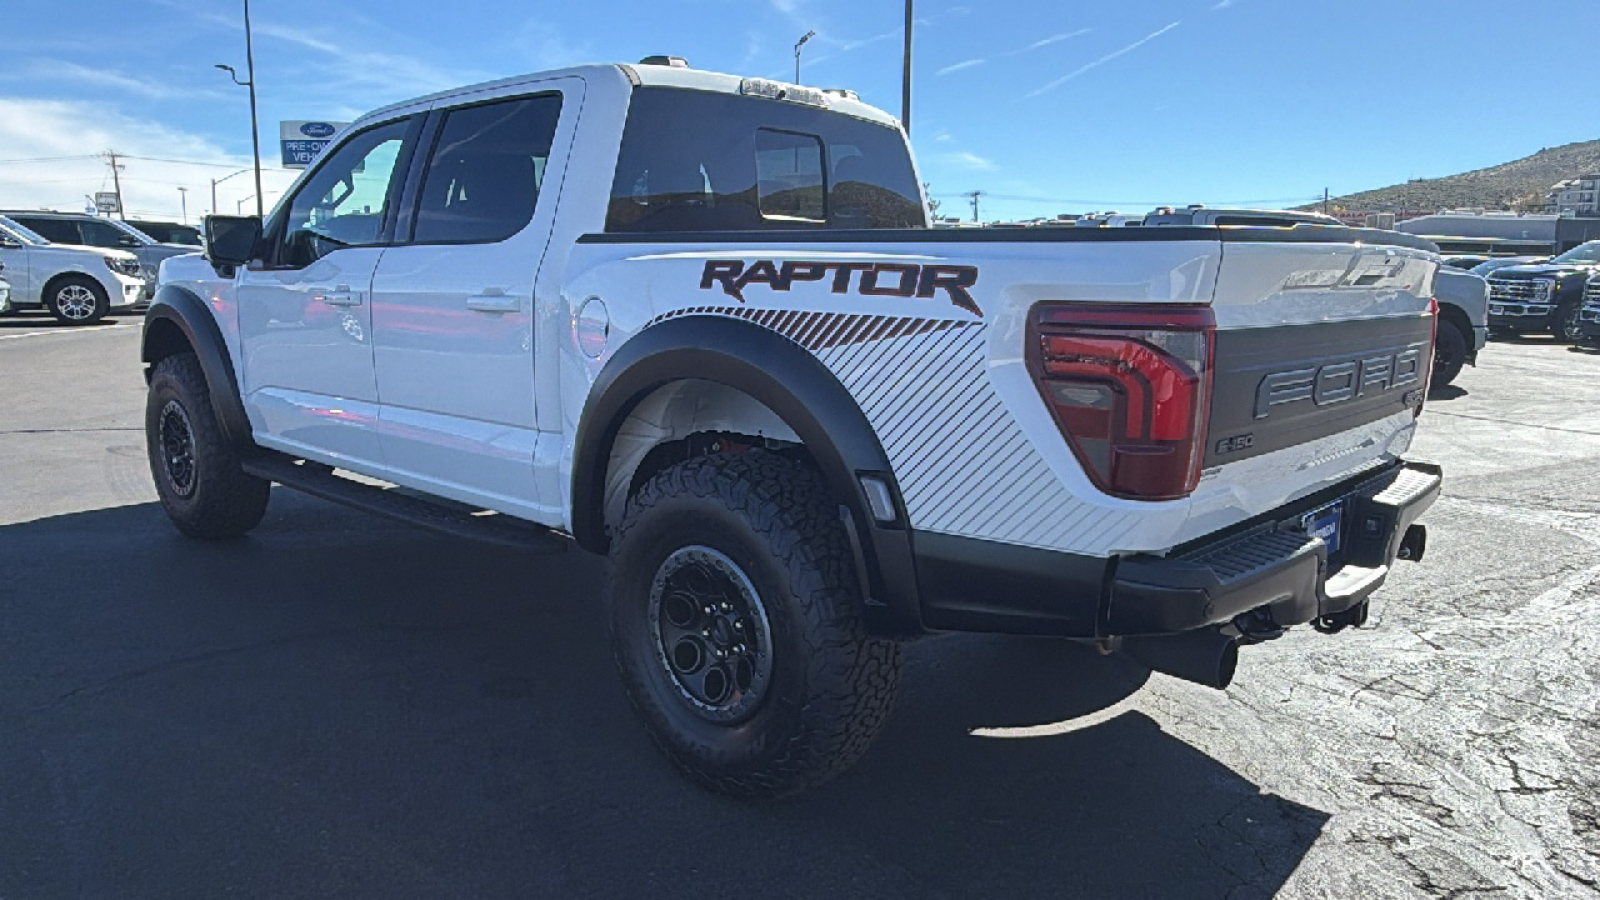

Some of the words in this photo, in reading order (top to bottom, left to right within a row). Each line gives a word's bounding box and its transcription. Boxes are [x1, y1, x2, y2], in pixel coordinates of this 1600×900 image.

[700, 259, 984, 318] RAPTOR
[1253, 349, 1420, 420] FORD
[1214, 433, 1254, 456] F-150
